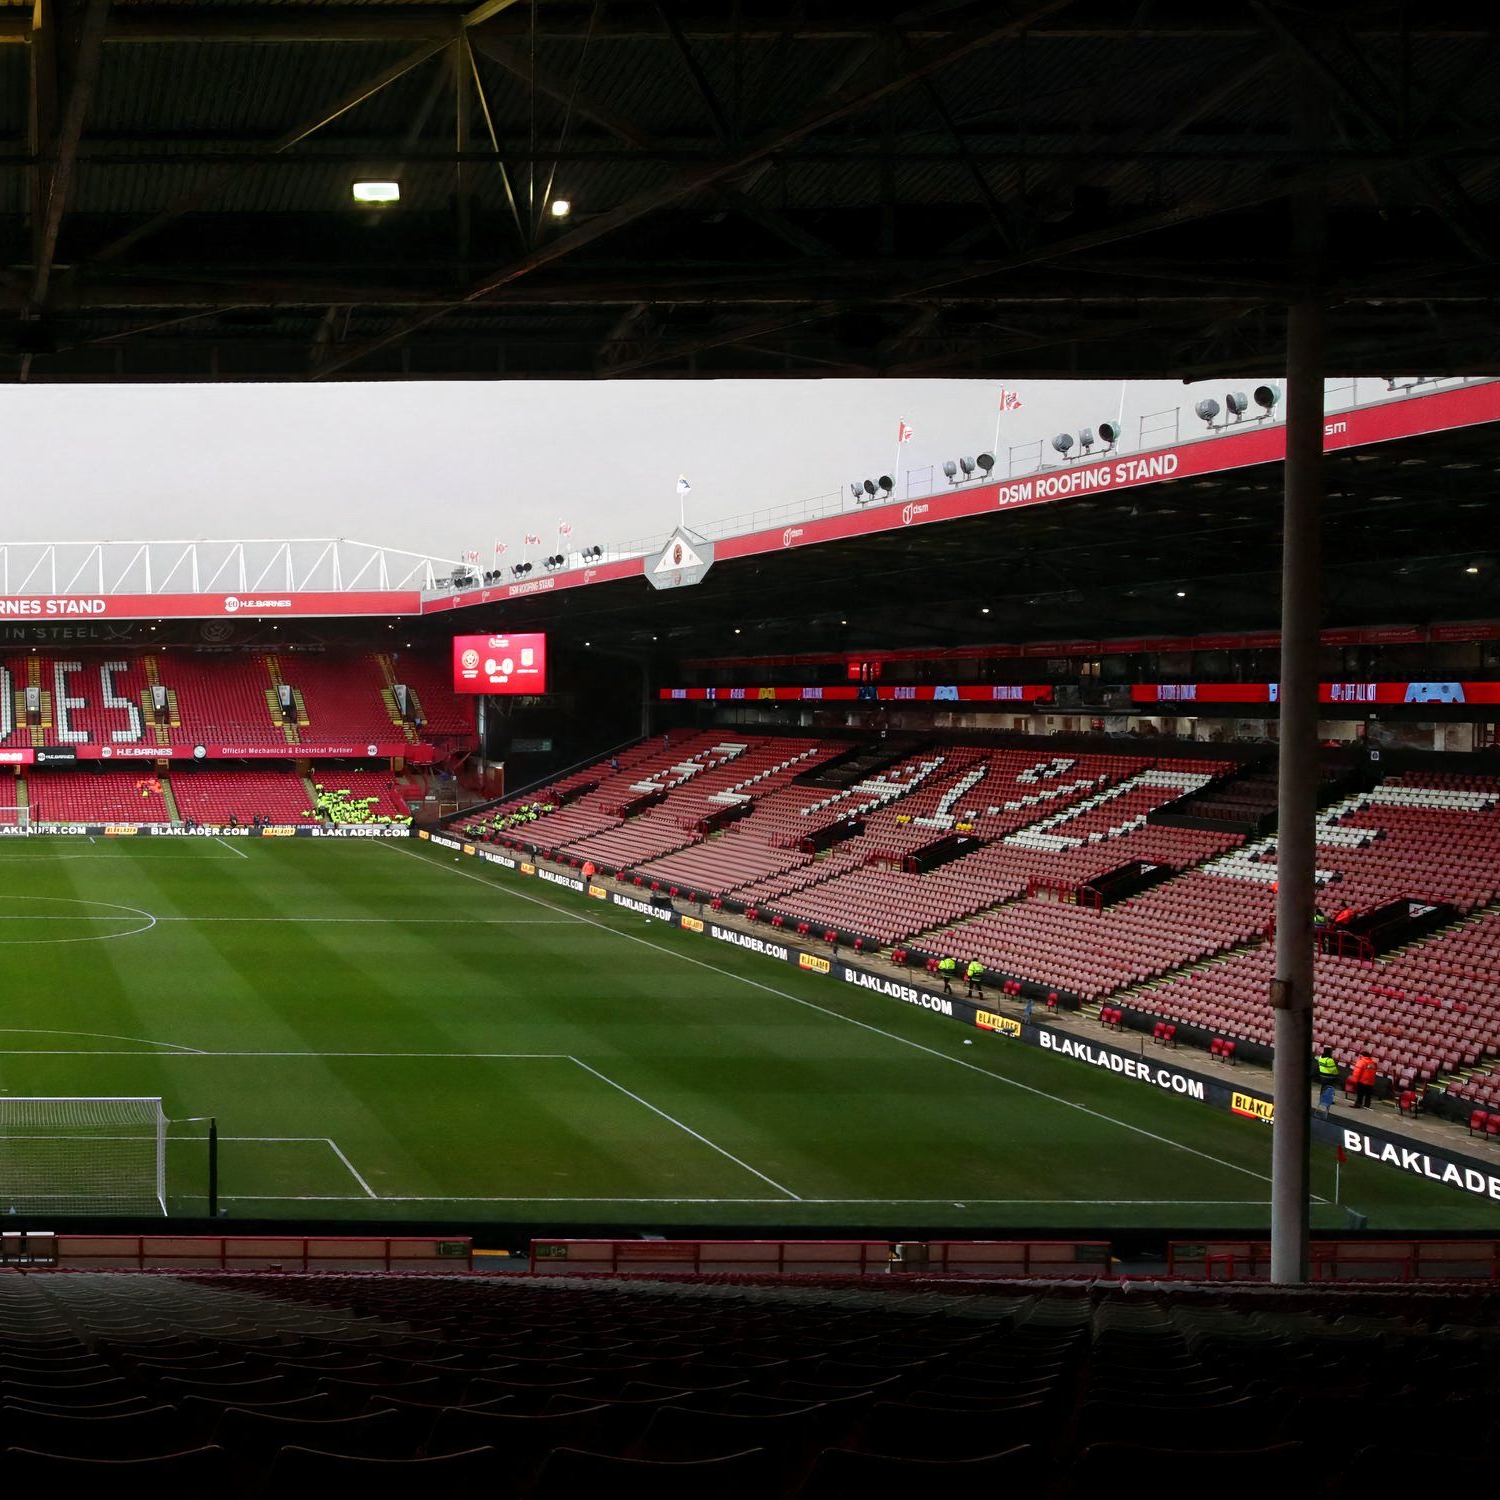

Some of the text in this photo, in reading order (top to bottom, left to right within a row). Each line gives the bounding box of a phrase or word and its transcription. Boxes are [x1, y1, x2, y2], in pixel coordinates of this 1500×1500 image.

[1325, 421, 1346, 435] sm
[999, 453, 1178, 505] DSM ROOFING STAND
[913, 504, 928, 514] dsm
[46, 600, 106, 614] STAND
[5, 628, 26, 639] IN
[36, 627, 99, 639] STEEL
[116, 748, 173, 756] H.E.BARNES
[151, 827, 249, 835] BLAKLADER.COM
[712, 926, 788, 960] BLAKLADER.COM
[845, 968, 953, 1016] BLAKLADER.COM
[1039, 1031, 1204, 1100] BLAKLADER.COM
[1343, 1129, 1500, 1200] BLAKLADE
